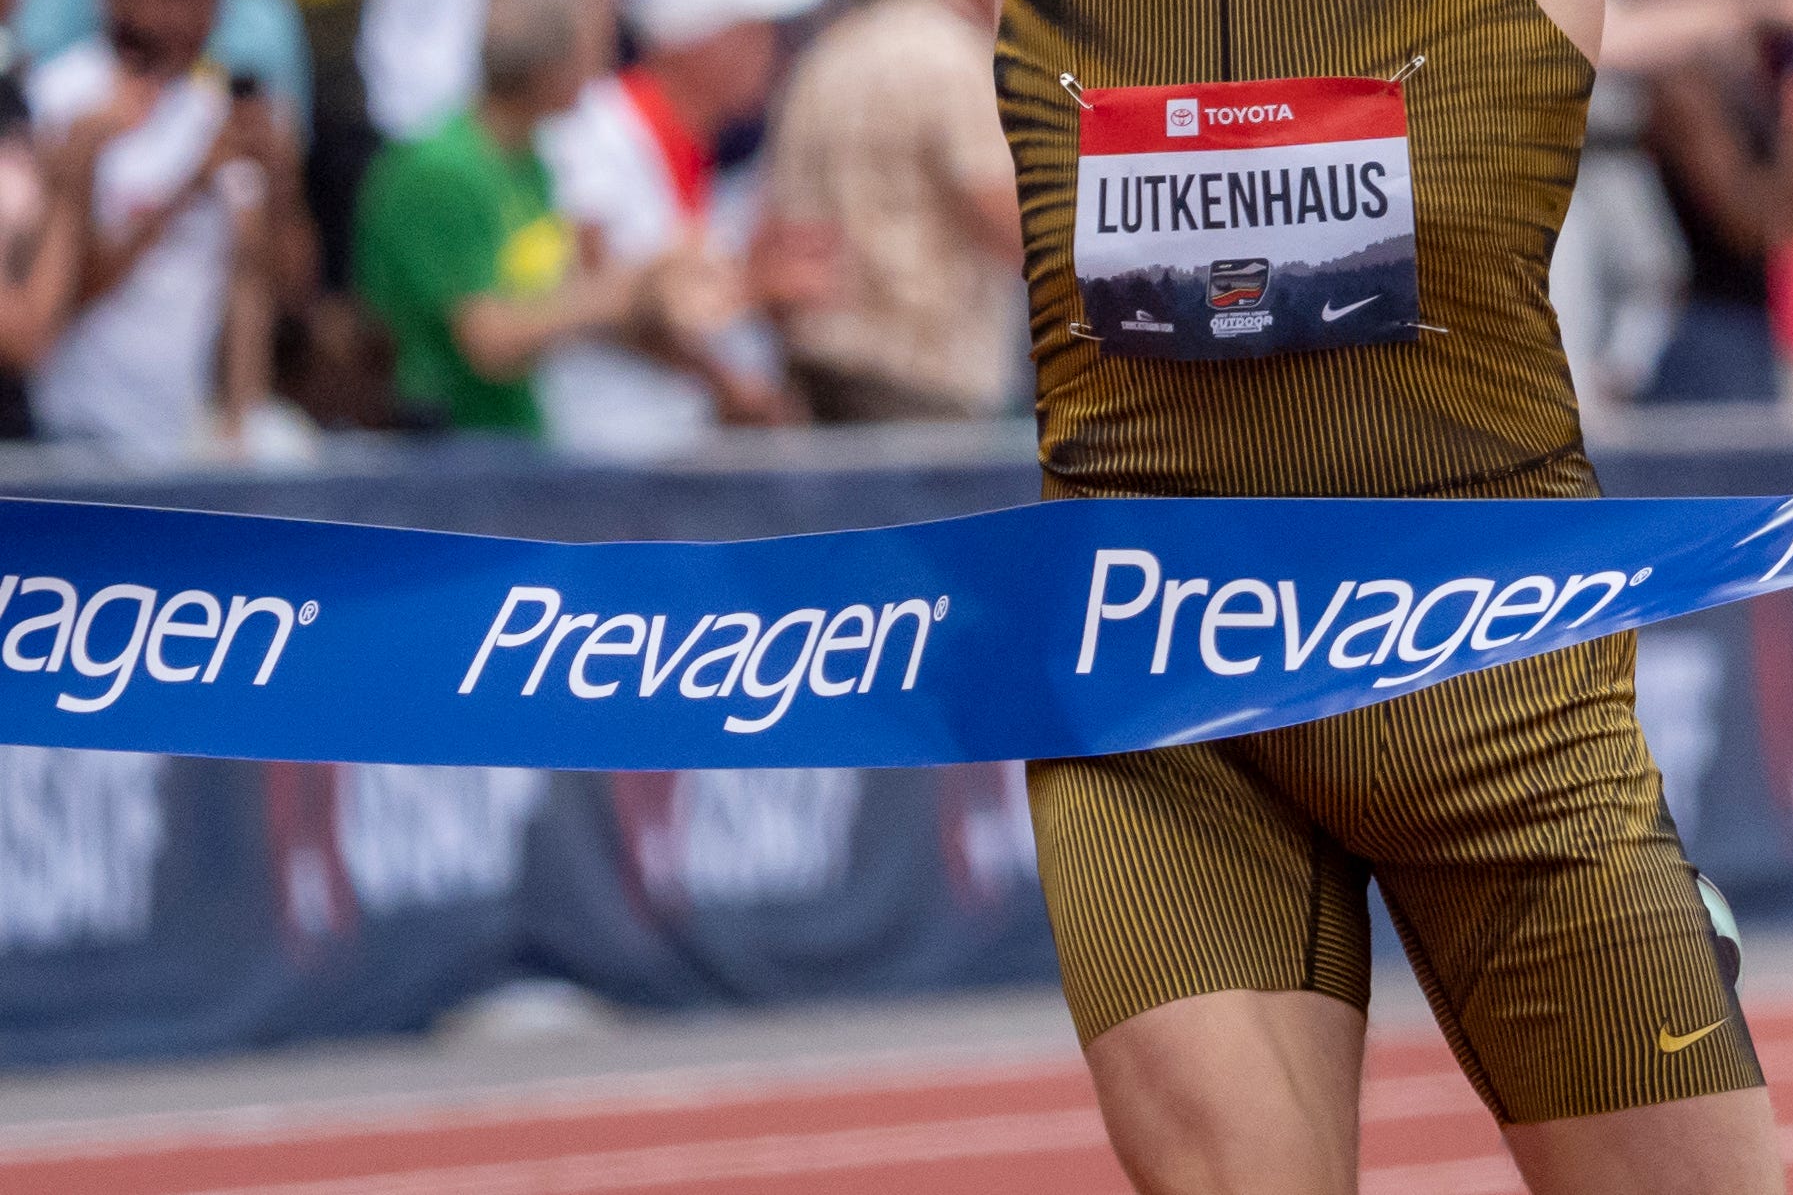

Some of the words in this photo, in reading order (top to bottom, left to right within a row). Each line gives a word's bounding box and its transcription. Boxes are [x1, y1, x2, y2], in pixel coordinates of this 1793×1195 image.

[1204, 103, 1294, 125] TOYOTA
[1097, 161, 1389, 234] LUTKENHAUS
[1210, 315, 1273, 330] OUTDOOR
